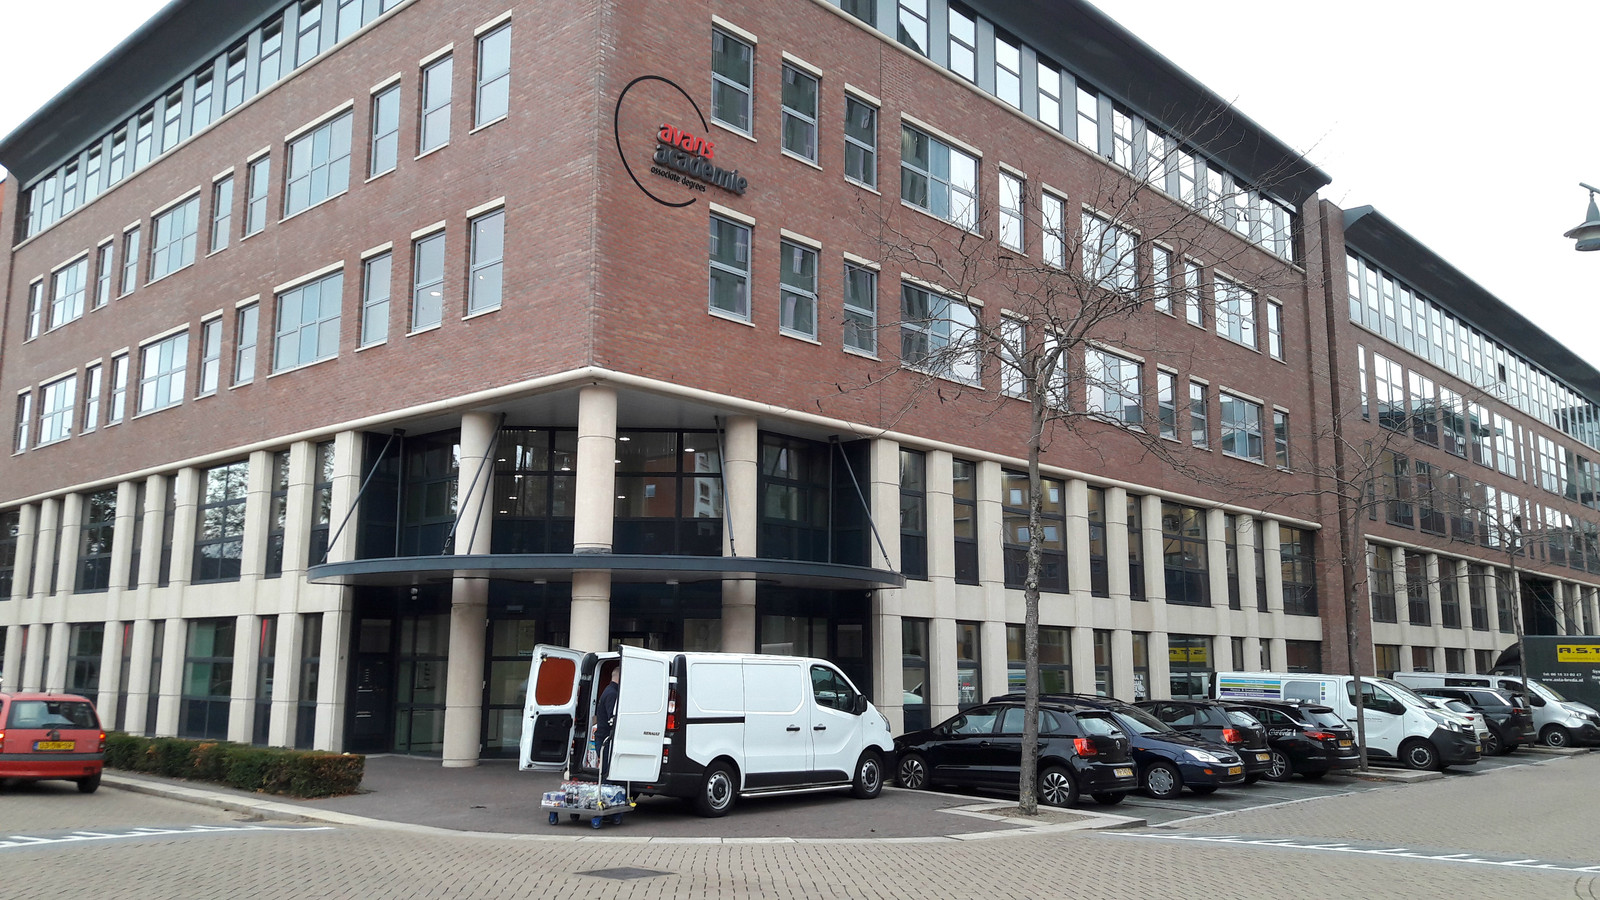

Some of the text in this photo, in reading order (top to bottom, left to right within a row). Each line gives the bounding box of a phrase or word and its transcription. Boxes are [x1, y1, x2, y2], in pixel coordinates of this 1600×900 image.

[658, 123, 715, 159] avans
[650, 166, 706, 192] associate degrees
[654, 144, 748, 195] academie
